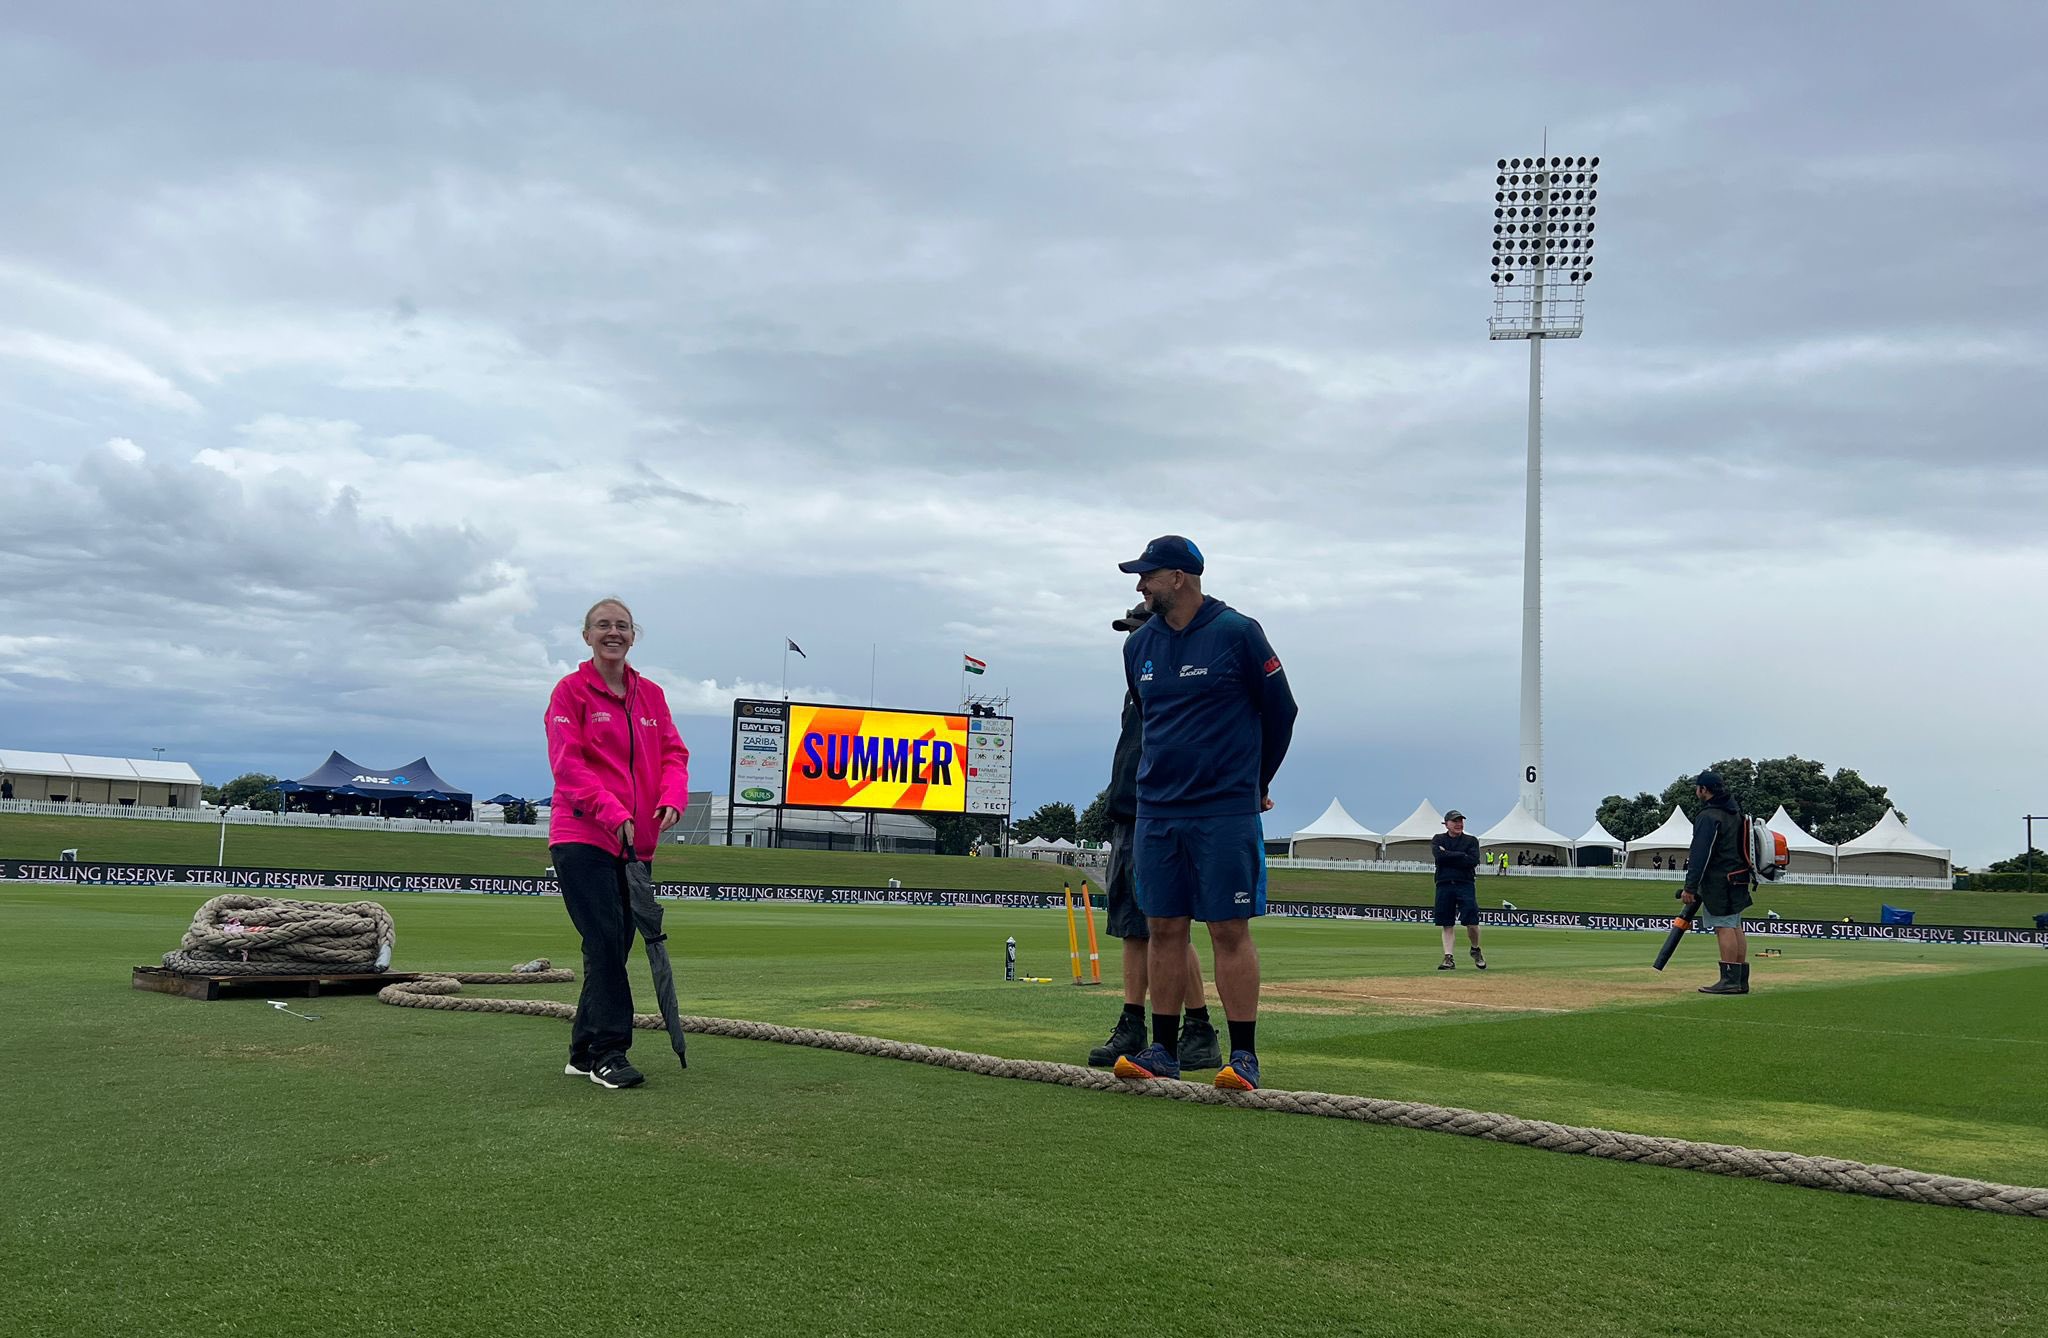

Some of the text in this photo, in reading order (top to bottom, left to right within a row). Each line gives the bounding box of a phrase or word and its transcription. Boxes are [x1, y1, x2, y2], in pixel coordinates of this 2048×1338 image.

[1140, 673, 1154, 681] ANZ
[754, 706, 781, 714] CRAIGS
[741, 723, 781, 733] BAYLEYS
[743, 736, 777, 746] ZARIBA
[801, 732, 953, 786] SUMMER
[351, 775, 390, 785] ANZ
[1526, 765, 1537, 783] 6
[983, 802, 1007, 810] TECT
[18, 864, 101, 881] STERLING
[106, 867, 175, 883] RESERVE
[185, 869, 325, 888] STERLING RESERVE
[334, 874, 462, 891] STERLING RESERVE
[469, 878, 533, 892] STERLING
[660, 884, 711, 897] RESERVE
[717, 886, 824, 900] STERLING RESERVE
[831, 889, 933, 903] STERLING RESERVE
[940, 892, 1039, 906] STERLING RESERVE
[1265, 903, 1357, 918] TERLING RESERVE
[1364, 907, 1418, 920] STERLING
[1532, 913, 1581, 926] RESERVE
[1588, 916, 1645, 929] STERLING
[1769, 922, 1824, 935] RESERVE
[1831, 925, 1955, 940] STERLING RESERVE
[1963, 929, 2031, 943] STERLING
